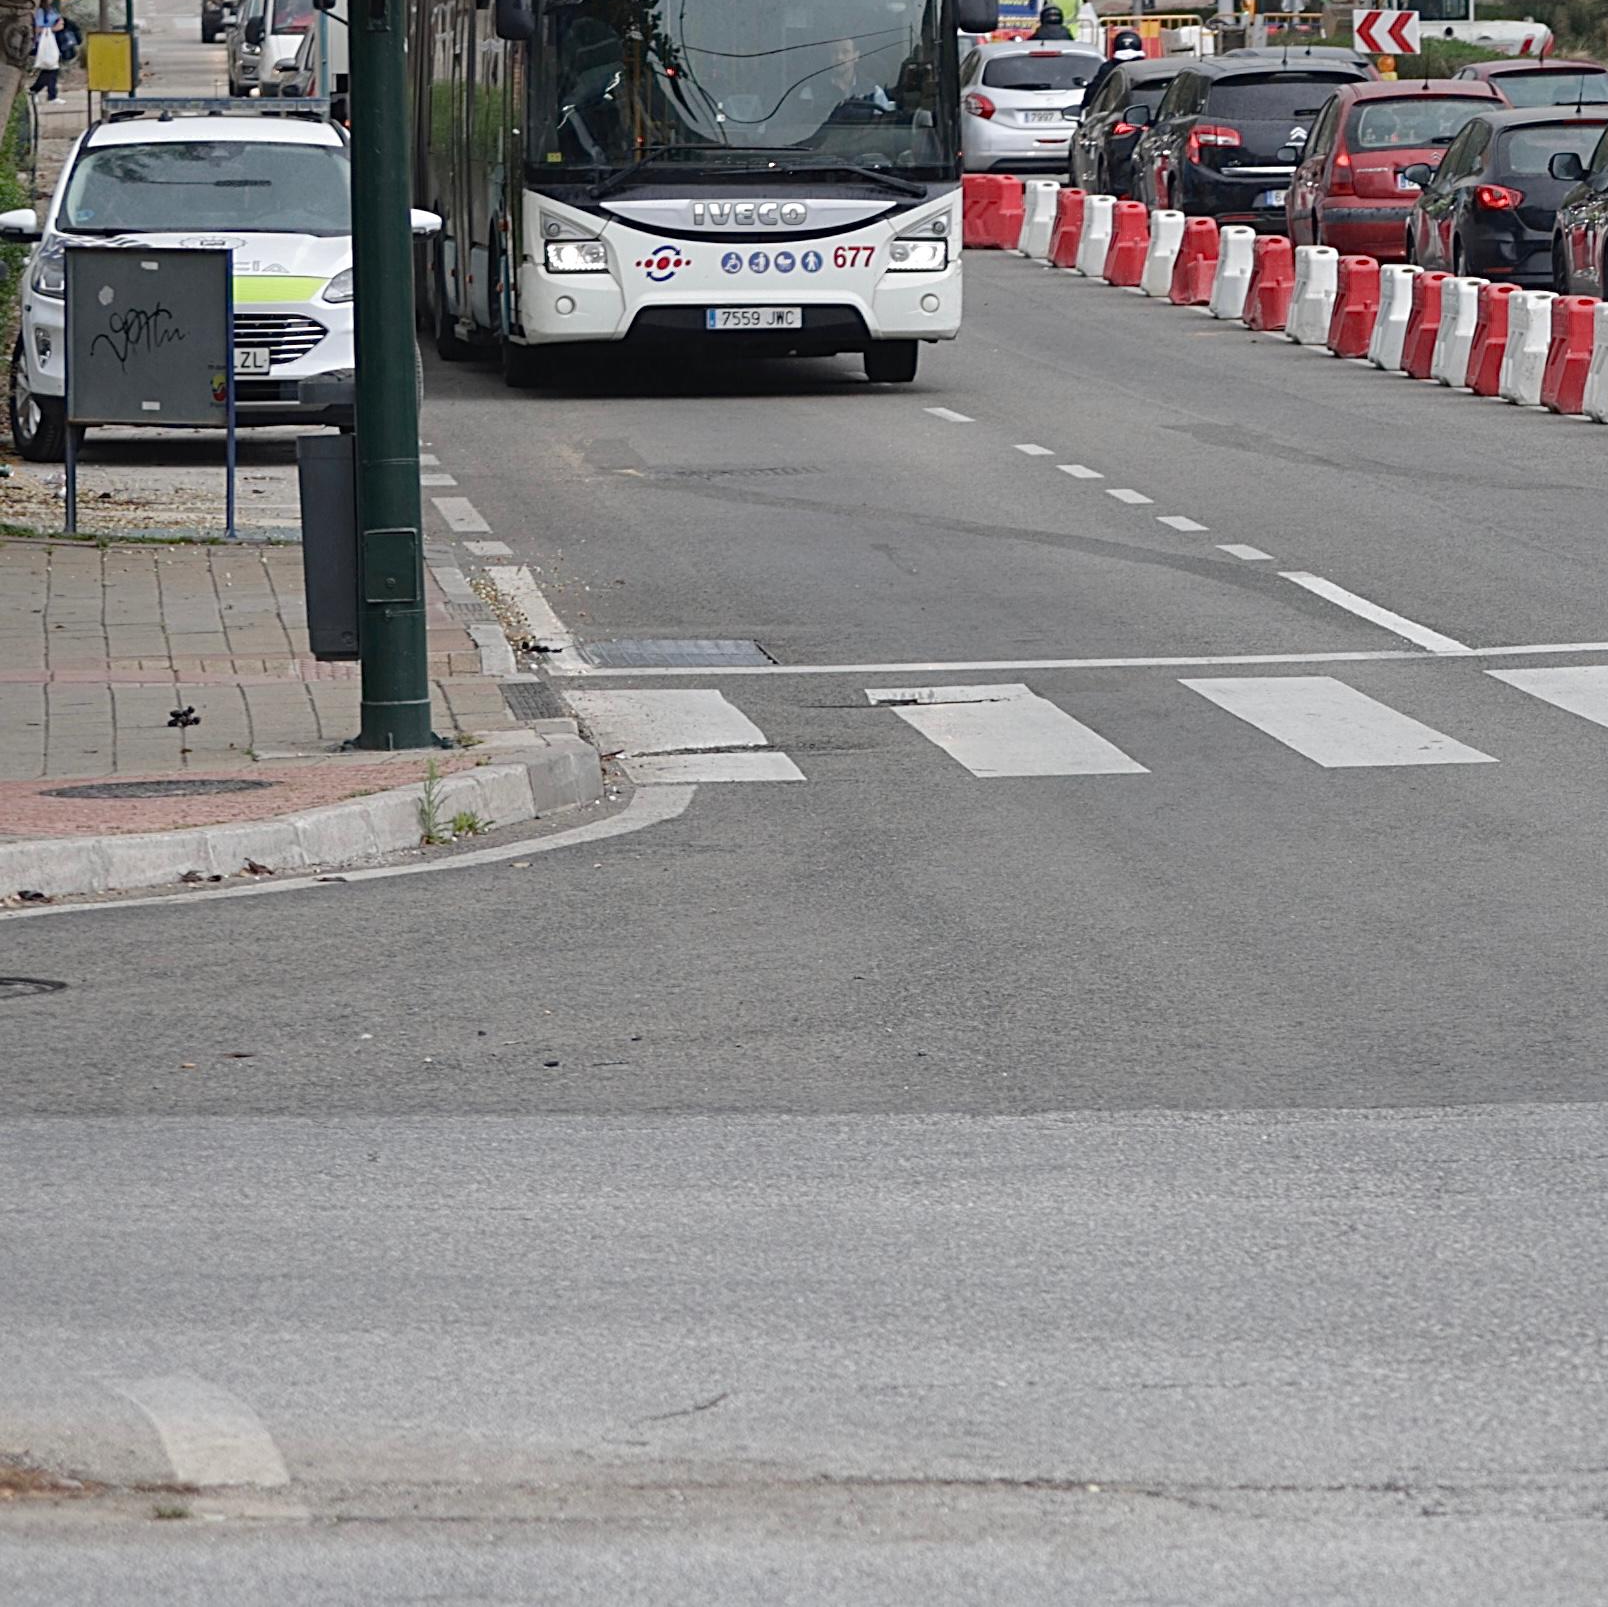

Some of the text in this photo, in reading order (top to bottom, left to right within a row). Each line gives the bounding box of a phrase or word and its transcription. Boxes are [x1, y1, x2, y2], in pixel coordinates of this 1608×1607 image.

[692, 201, 808, 226] IVECO
[833, 246, 876, 268] 677
[721, 310, 795, 326] 7559 JWC
